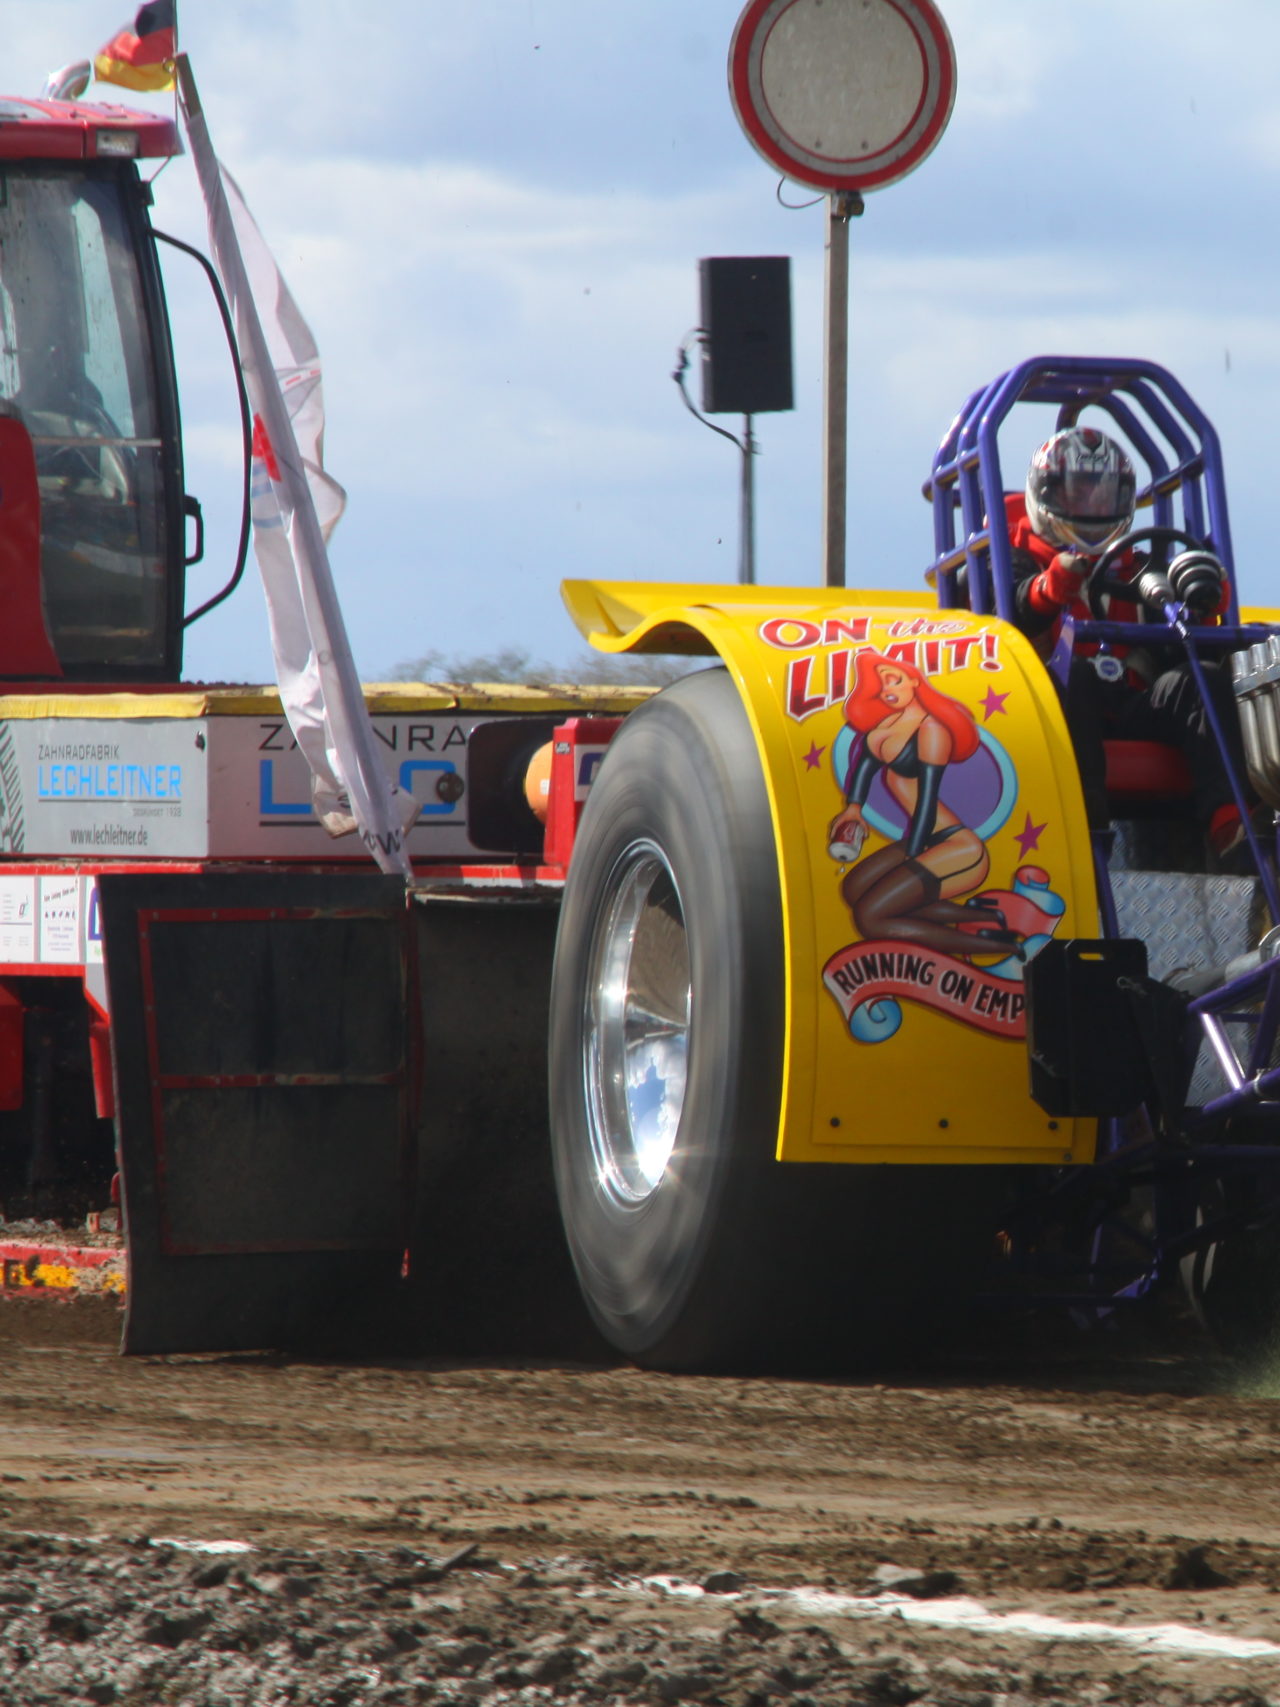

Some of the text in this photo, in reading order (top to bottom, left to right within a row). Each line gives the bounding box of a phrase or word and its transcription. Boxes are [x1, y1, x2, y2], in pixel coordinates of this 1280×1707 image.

[759, 616, 970, 650] ON the
[38, 744, 120, 761] ZAHNRADFABRIK
[38, 764, 183, 797] LECHLEITNER
[70, 824, 149, 846] www.lechleitner.de
[832, 951, 1026, 1023] RUNNING ON EMP
